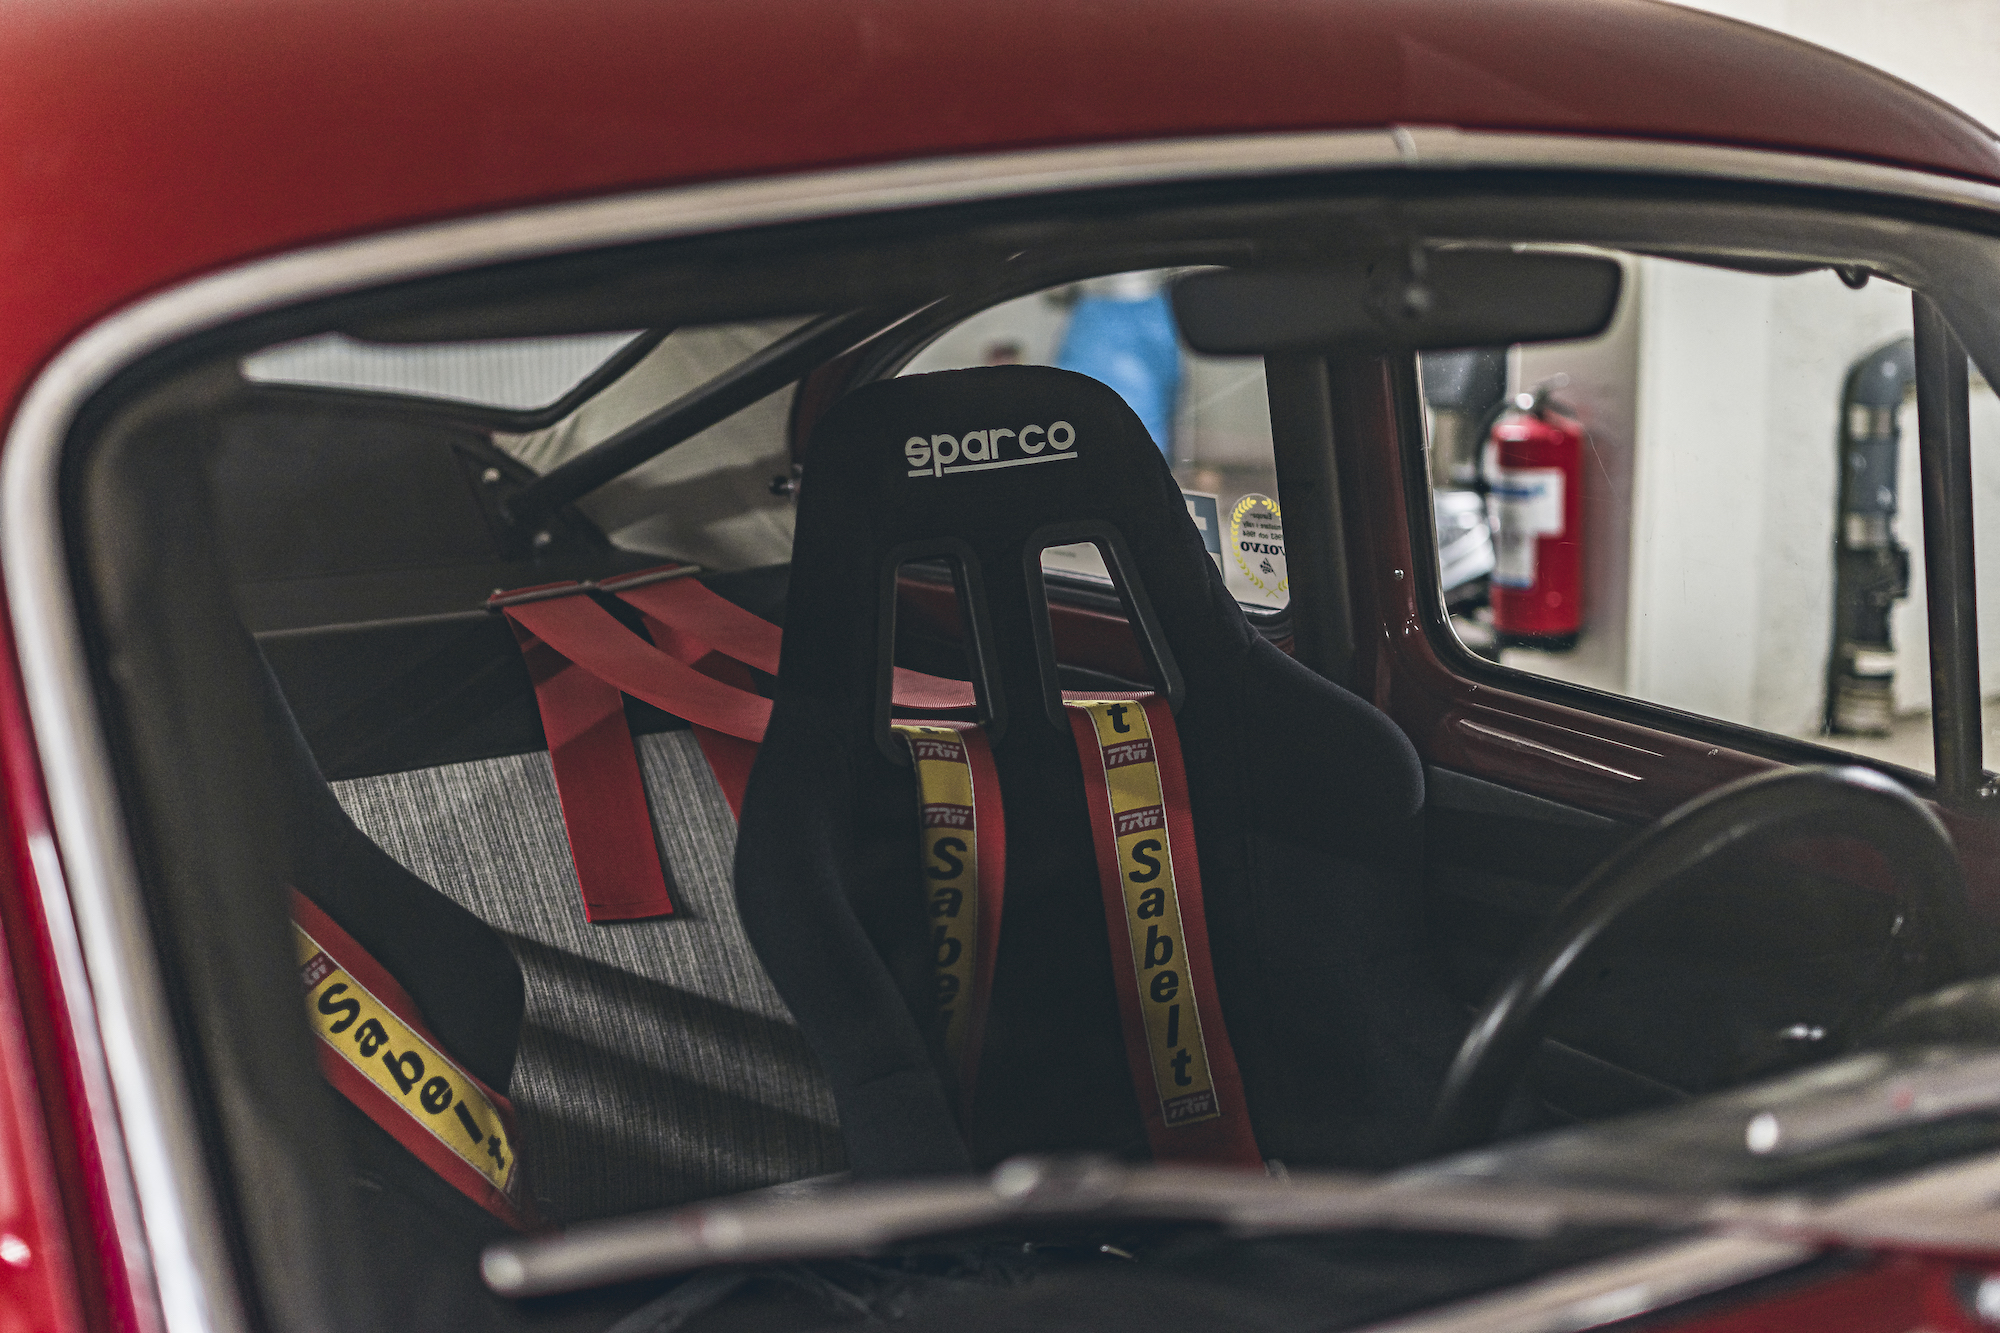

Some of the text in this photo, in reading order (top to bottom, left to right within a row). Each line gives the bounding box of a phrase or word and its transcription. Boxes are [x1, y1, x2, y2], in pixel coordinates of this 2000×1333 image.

[904, 420, 1077, 477] sparco
[916, 741, 960, 760] TRW
[1107, 742, 1150, 767] TRW
[924, 806, 970, 826] TRW
[1118, 809, 1162, 833] TRW
[1128, 838, 1193, 1087] Sabelt
[317, 982, 506, 1171] Sabelt
